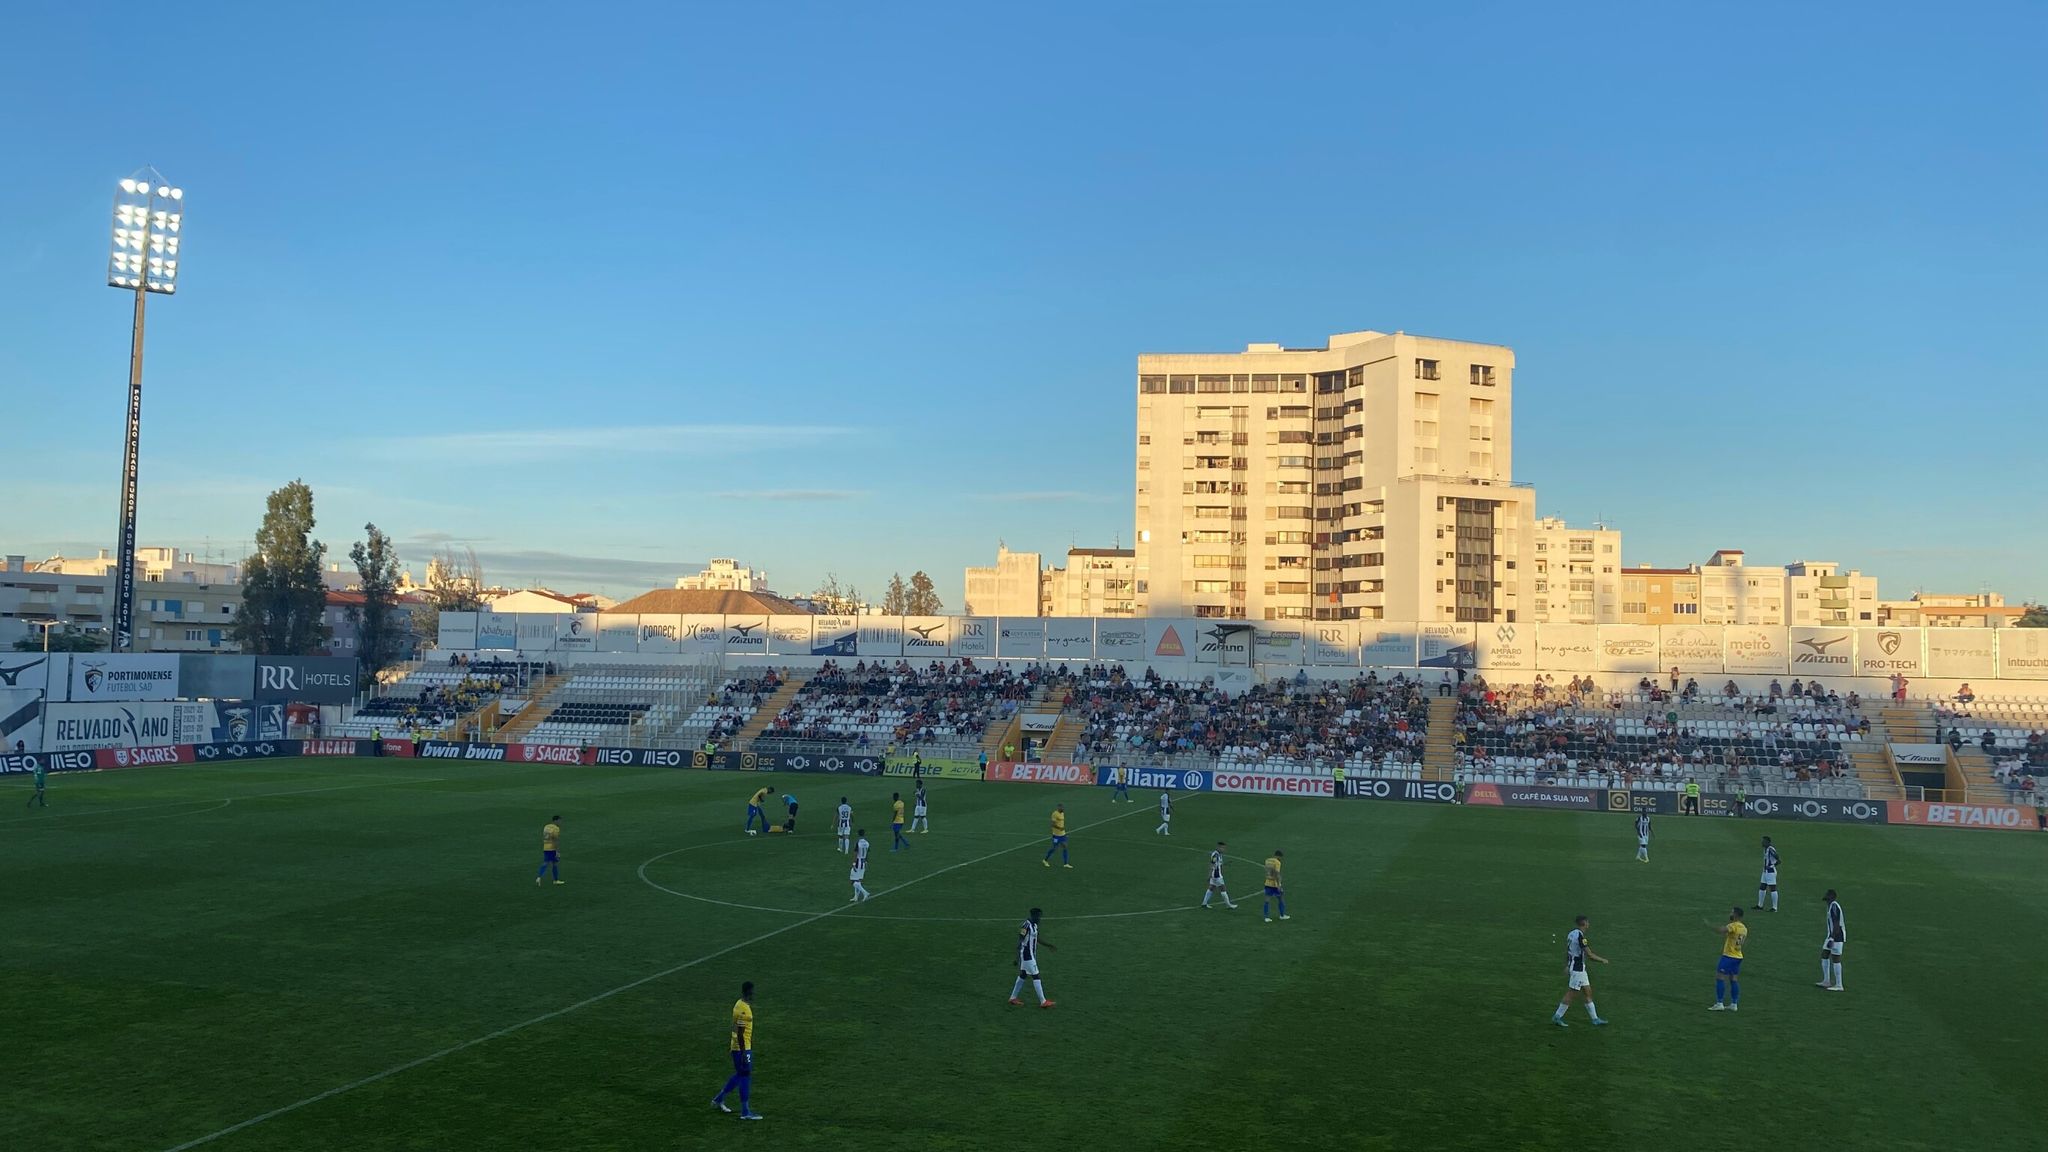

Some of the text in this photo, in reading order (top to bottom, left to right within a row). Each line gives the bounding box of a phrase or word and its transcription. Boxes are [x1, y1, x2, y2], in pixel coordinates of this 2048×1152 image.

[962, 623, 984, 636] RR
[1319, 629, 1344, 642] RR
[961, 641, 985, 651] Hotels
[1730, 639, 1771, 650] metro
[1318, 648, 1345, 658] Hotels
[1863, 660, 1917, 669] PRO-TECH
[108, 670, 172, 681] PORTIMONENSE
[260, 665, 351, 690] RR HOTELS
[107, 682, 153, 693] FUTEBOL SAD
[56, 718, 121, 741] RELVADO
[141, 717, 169, 738] ANO
[132, 745, 179, 765] SAGRES
[198, 745, 220, 759] NOS
[226, 743, 248, 757] NOS
[255, 742, 275, 755] NOS
[422, 741, 460, 758] bwin
[465, 743, 504, 760] bwin
[537, 745, 580, 763] SAGRES
[758, 757, 775, 766] ESC
[786, 756, 810, 770] NOS
[819, 757, 844, 771] NOS
[853, 758, 878, 773] NOS
[1011, 763, 1080, 782] BETANO
[1215, 774, 1334, 794] CONTINENTE
[1474, 790, 1497, 798] DELTA
[1520, 792, 1539, 800] CAFÉ
[1553, 794, 1569, 802] SUA
[1633, 796, 1657, 806] ESC
[1703, 799, 1728, 809] ESC
[1744, 798, 1779, 815] NOS
[1793, 800, 1828, 817] NOS
[1842, 802, 1878, 819] NOS
[1927, 804, 2020, 827] BETANO
